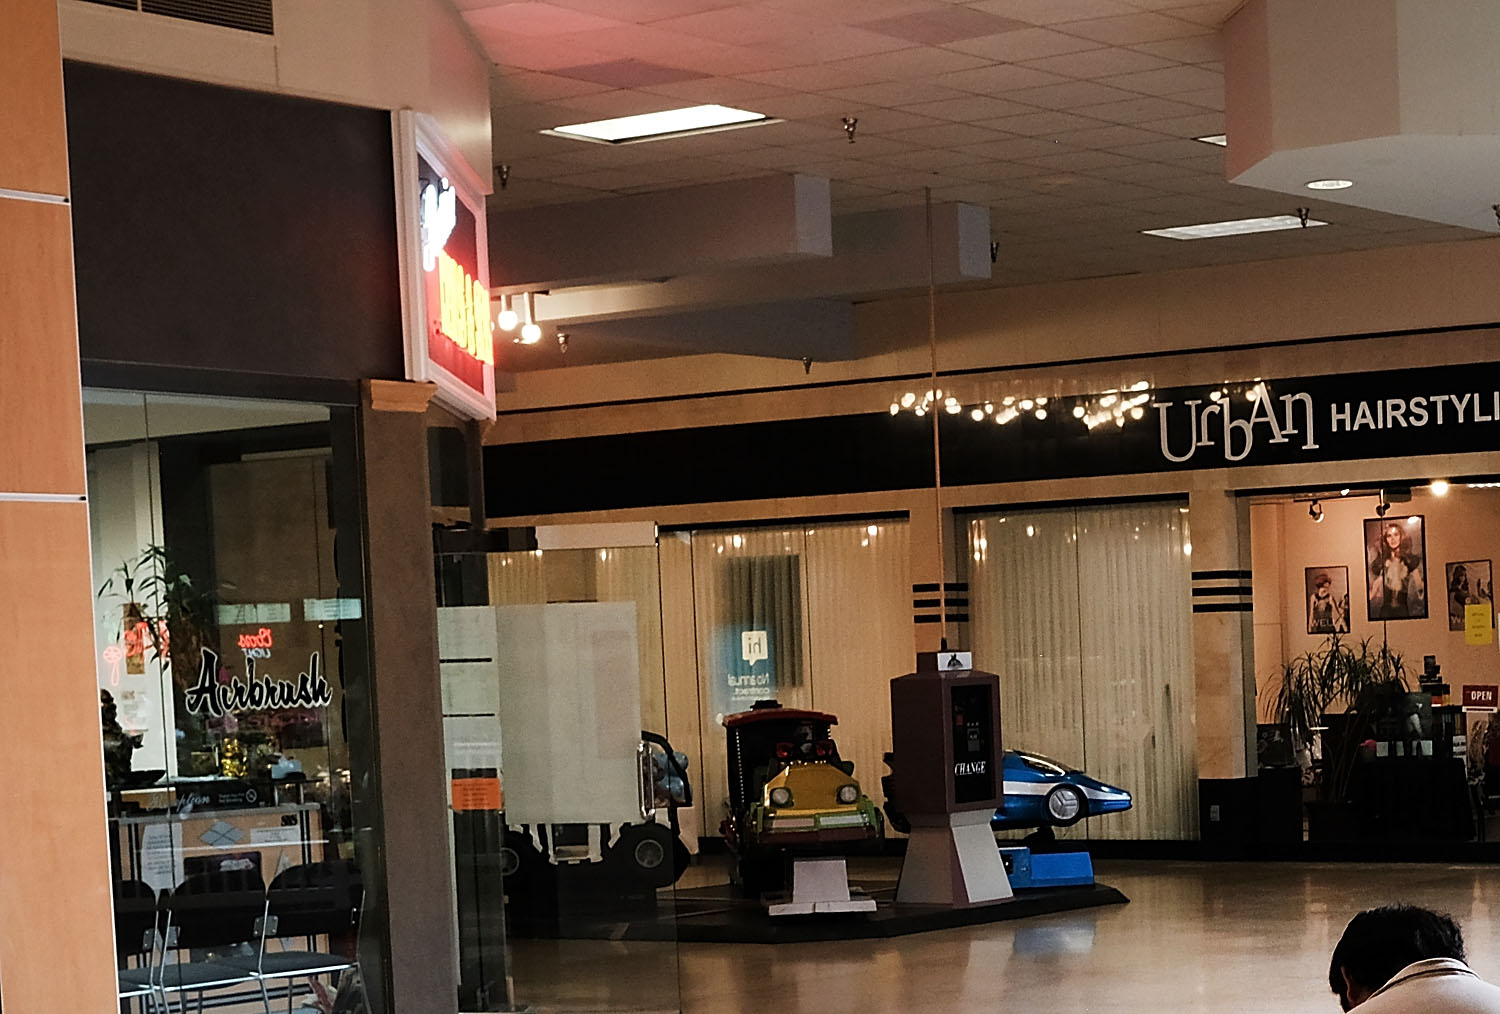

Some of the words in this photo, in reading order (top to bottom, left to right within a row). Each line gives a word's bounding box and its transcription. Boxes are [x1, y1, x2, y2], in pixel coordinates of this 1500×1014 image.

[185, 647, 332, 718] Airbrush
[1471, 690, 1492, 701] OPEN
[954, 761, 986, 776] CHANGE
